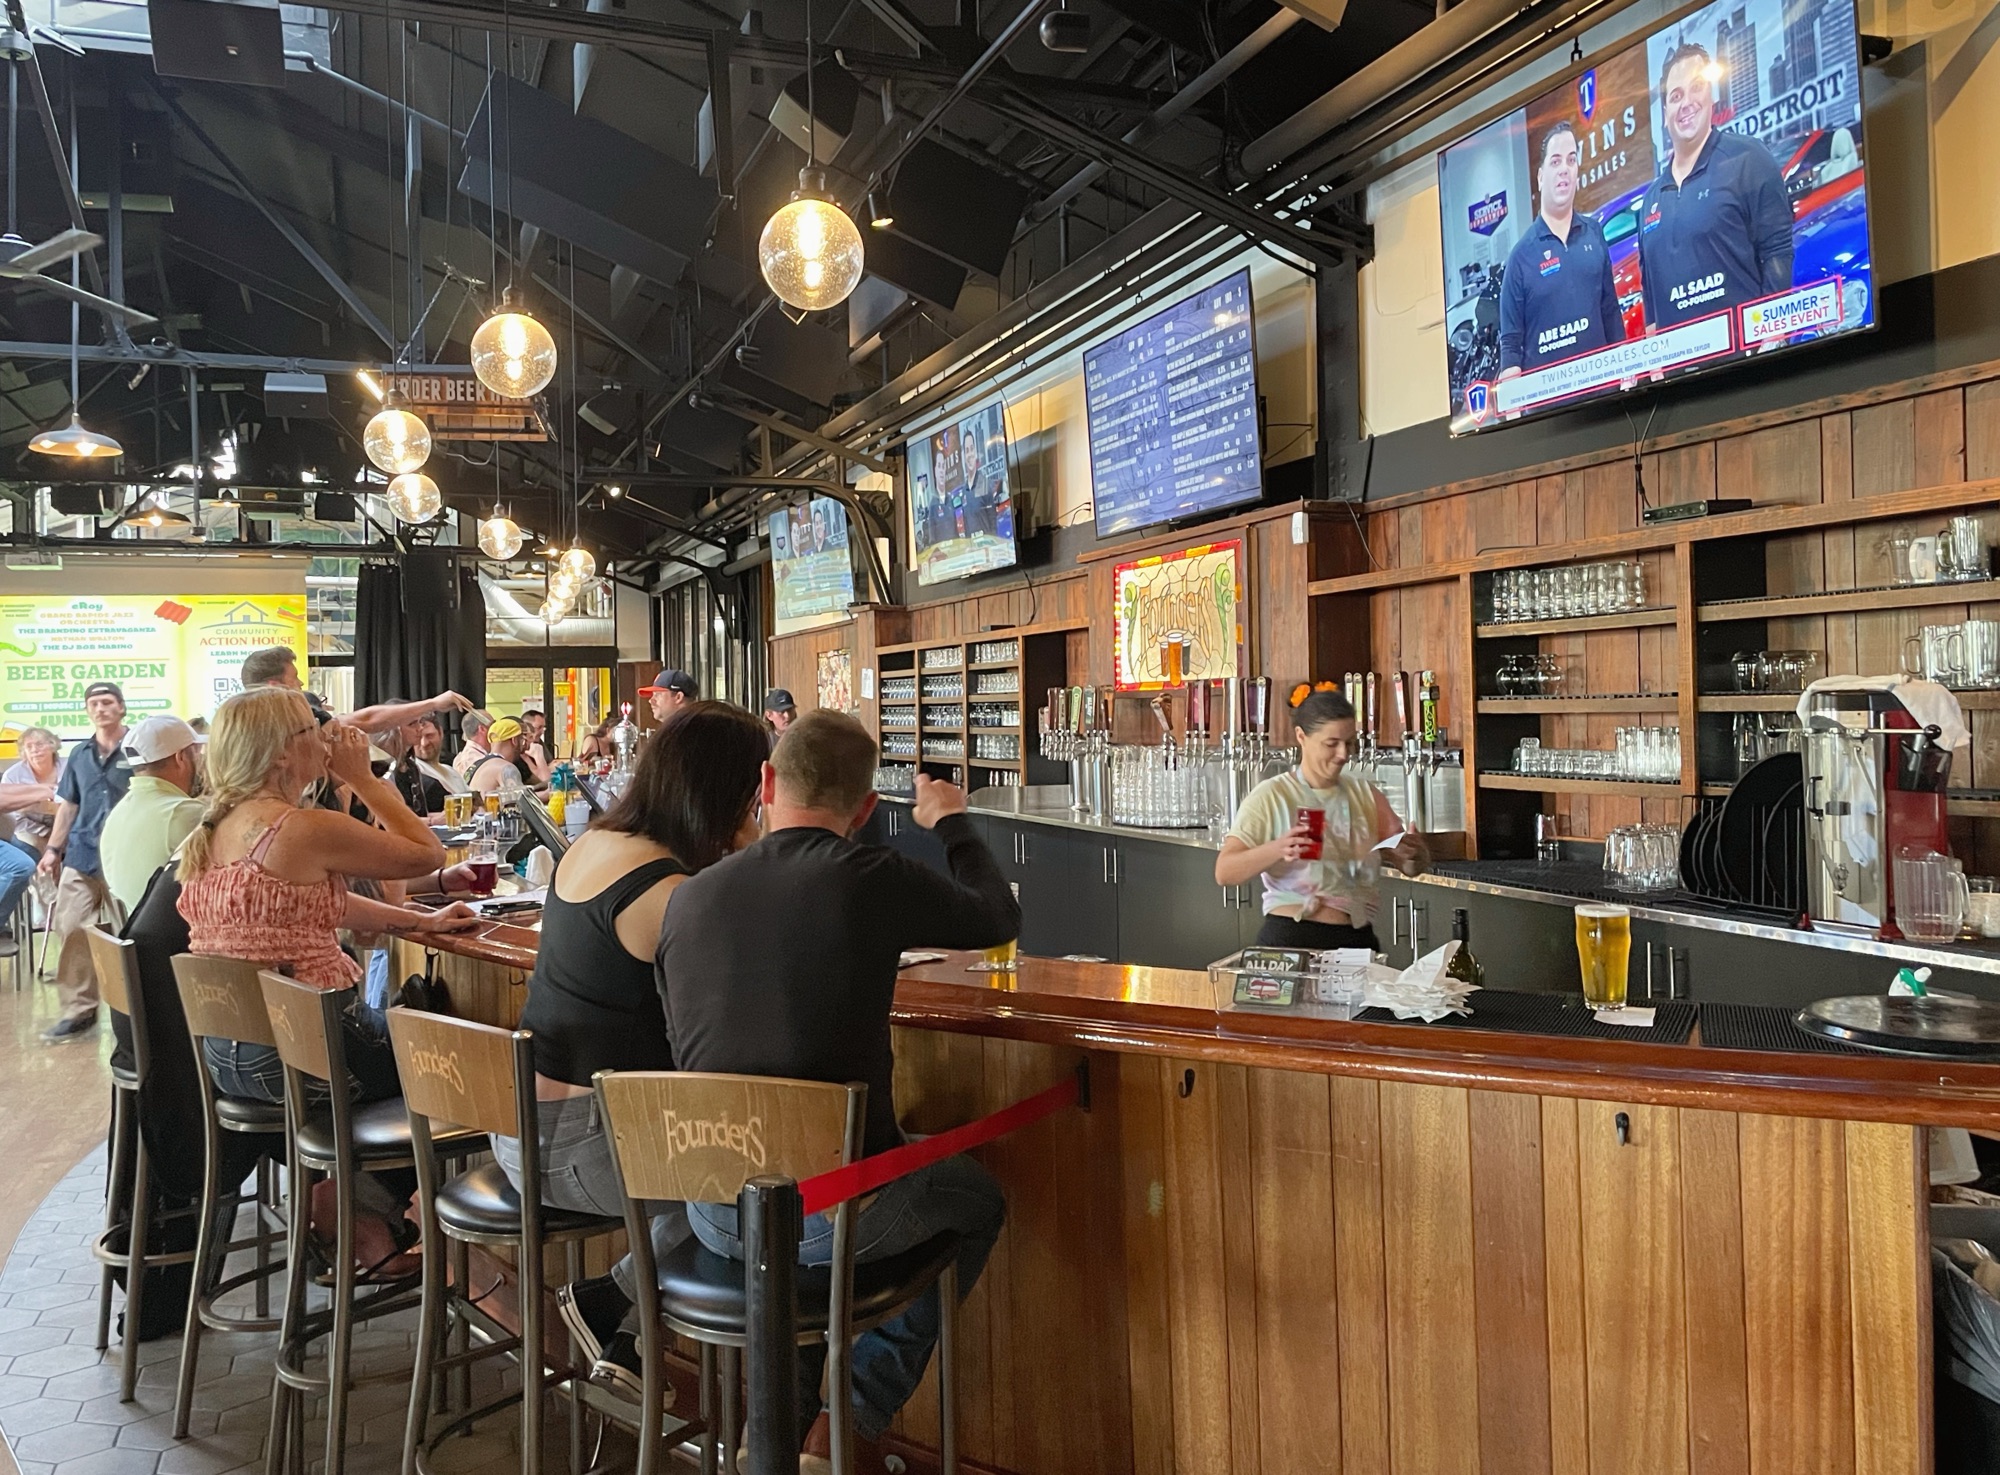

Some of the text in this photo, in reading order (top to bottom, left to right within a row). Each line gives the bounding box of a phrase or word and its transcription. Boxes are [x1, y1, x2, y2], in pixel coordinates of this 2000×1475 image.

[1670, 272, 1724, 302] AL SAAD
[1676, 288, 1726, 310] CO-FOUNDER
[1763, 295, 1818, 322] SUMMER
[1538, 317, 1590, 346] ABE SAAD
[1753, 305, 1830, 337] SALES EVENT
[1538, 335, 1577, 354] CO-FOUNDER
[1541, 338, 1670, 385] TWINSAUTOSALES.COM
[446, 380, 486, 401] BEER
[200, 636, 295, 646] ACTION HOUSE
[7, 664, 166, 680] BEER GARDEN
[35, 714, 90, 727] JUNE
[1246, 960, 1293, 972] ALL DAY
